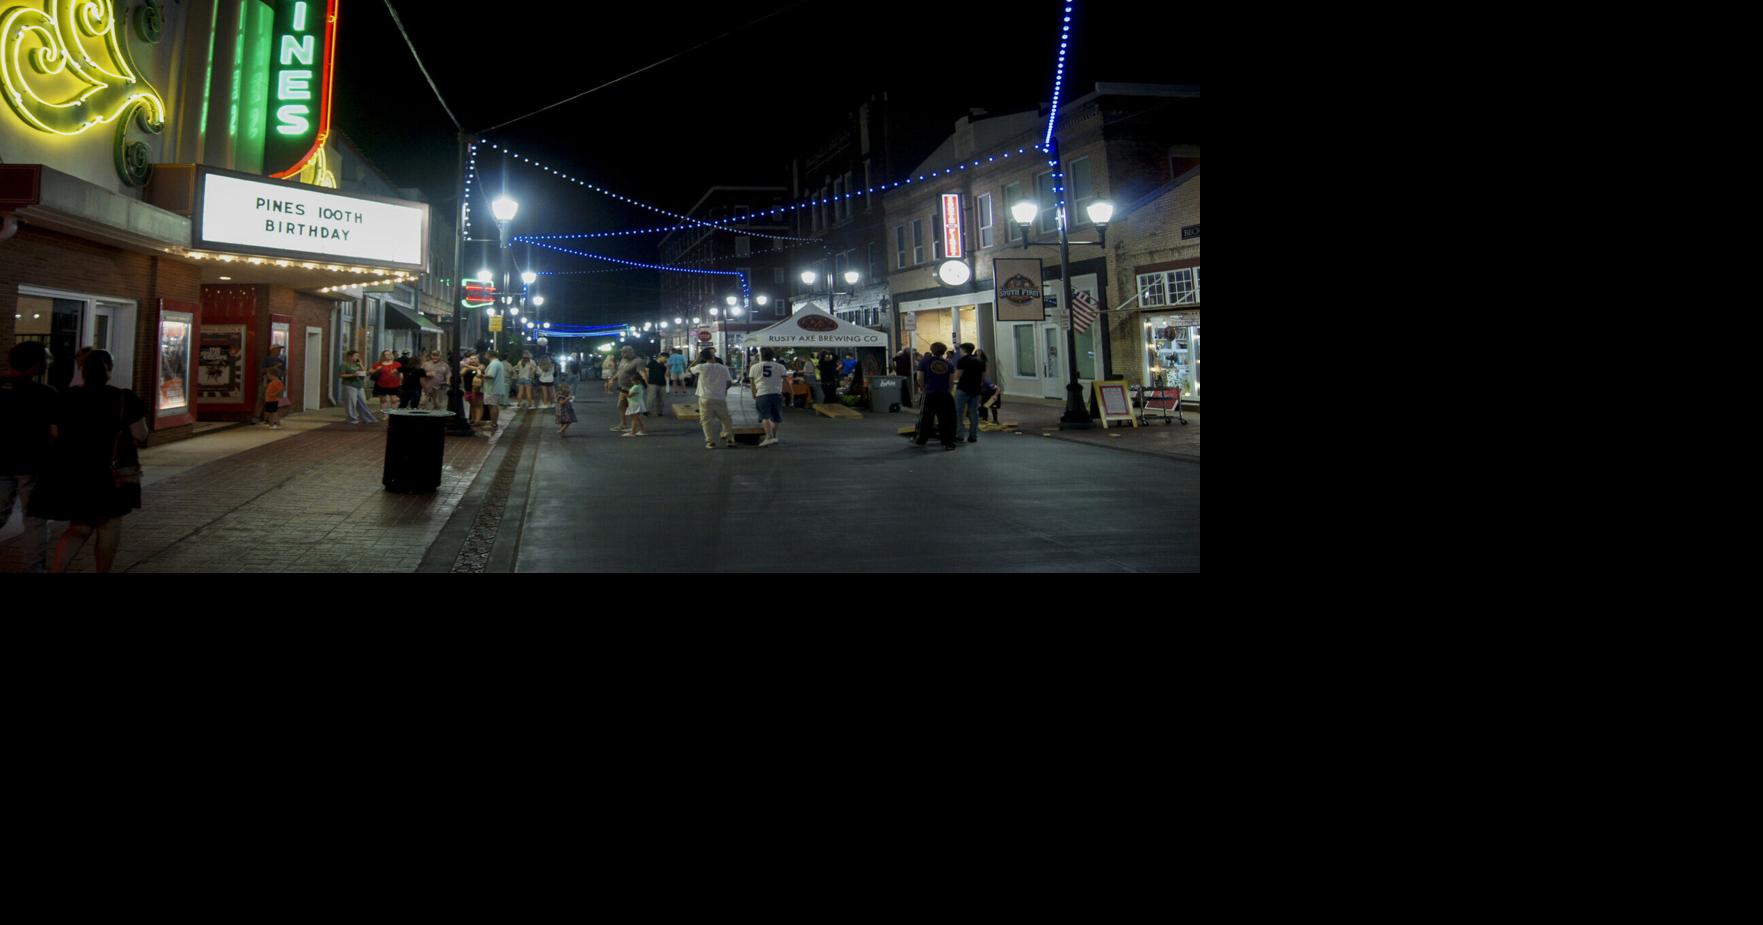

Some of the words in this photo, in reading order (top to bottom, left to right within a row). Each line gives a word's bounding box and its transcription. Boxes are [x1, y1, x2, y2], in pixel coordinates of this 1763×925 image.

[256, 197, 305, 216] PINES
[265, 219, 350, 241] BIRTHDAY
[818, 335, 861, 343] BREWING
[863, 335, 878, 343] CO
[762, 365, 772, 378] 5
